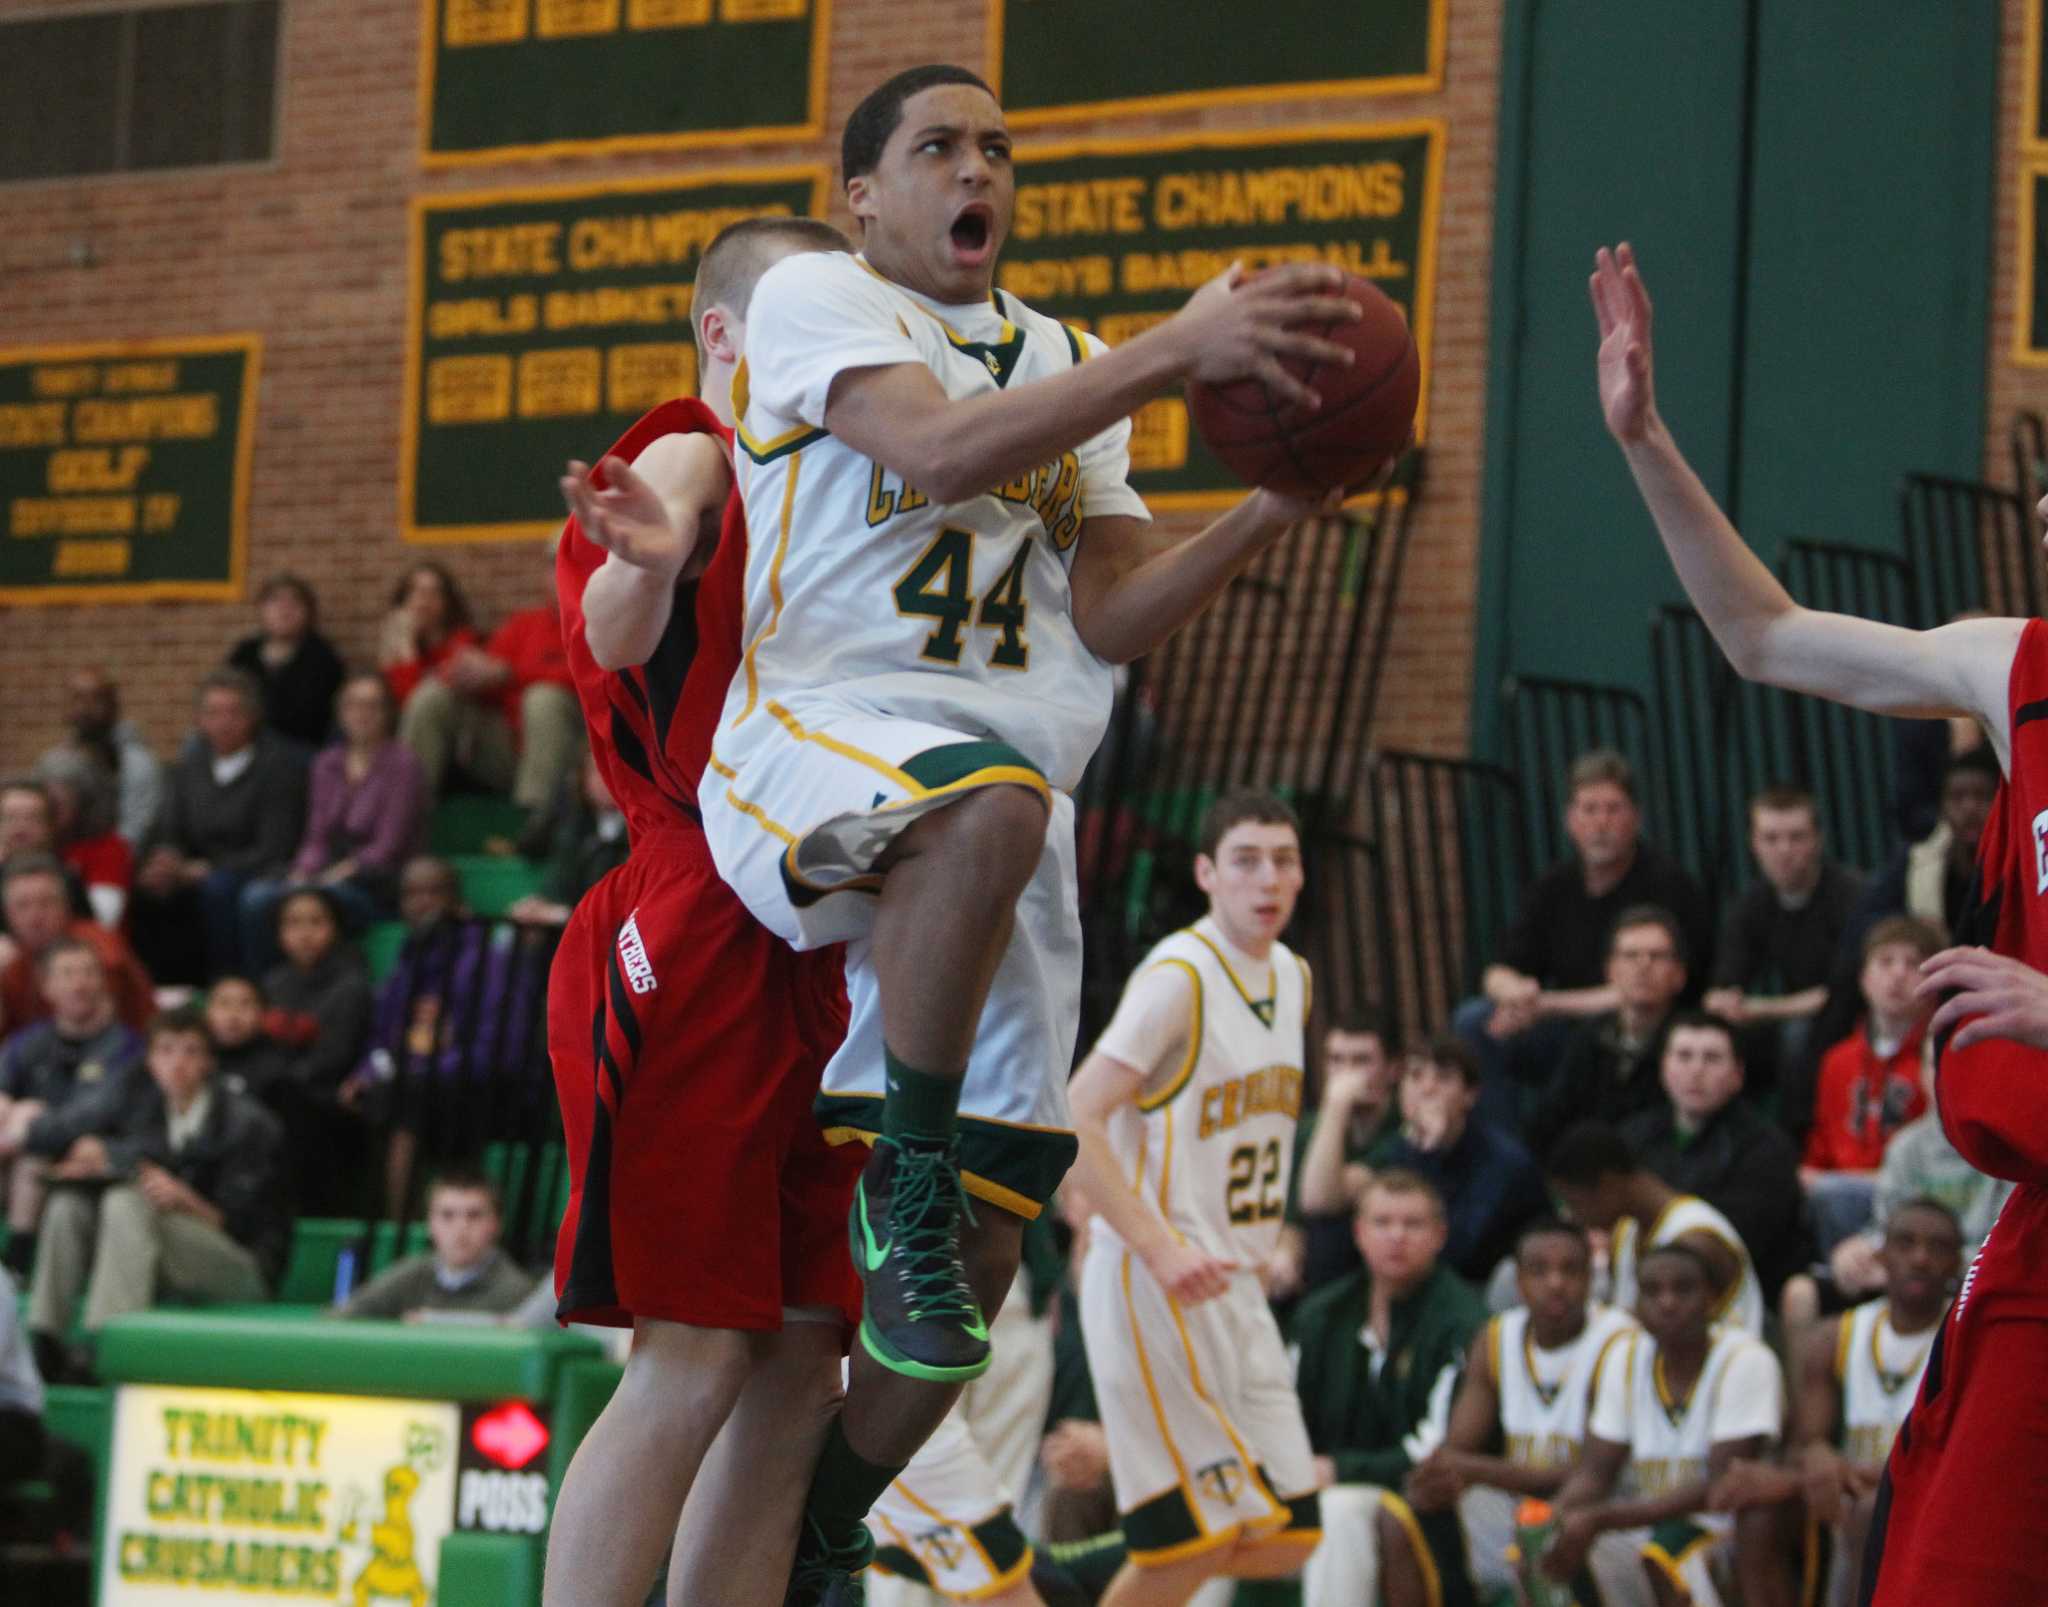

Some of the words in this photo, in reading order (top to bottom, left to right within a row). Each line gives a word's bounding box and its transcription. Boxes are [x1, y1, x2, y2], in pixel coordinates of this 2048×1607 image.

[1013, 176, 1146, 240] STATE
[1152, 160, 1405, 229] CHAMPIONS
[440, 221, 562, 283] STATE
[568, 204, 794, 272] CHAMP
[49, 446, 150, 491] GOLF
[892, 522, 1031, 672] 44
[1226, 1137, 1285, 1228] 22
[162, 1407, 329, 1469] TRINITY
[147, 1470, 330, 1533] CATHOLIC
[458, 1470, 548, 1532] POSS
[119, 1531, 341, 1600] CRUSADERS
